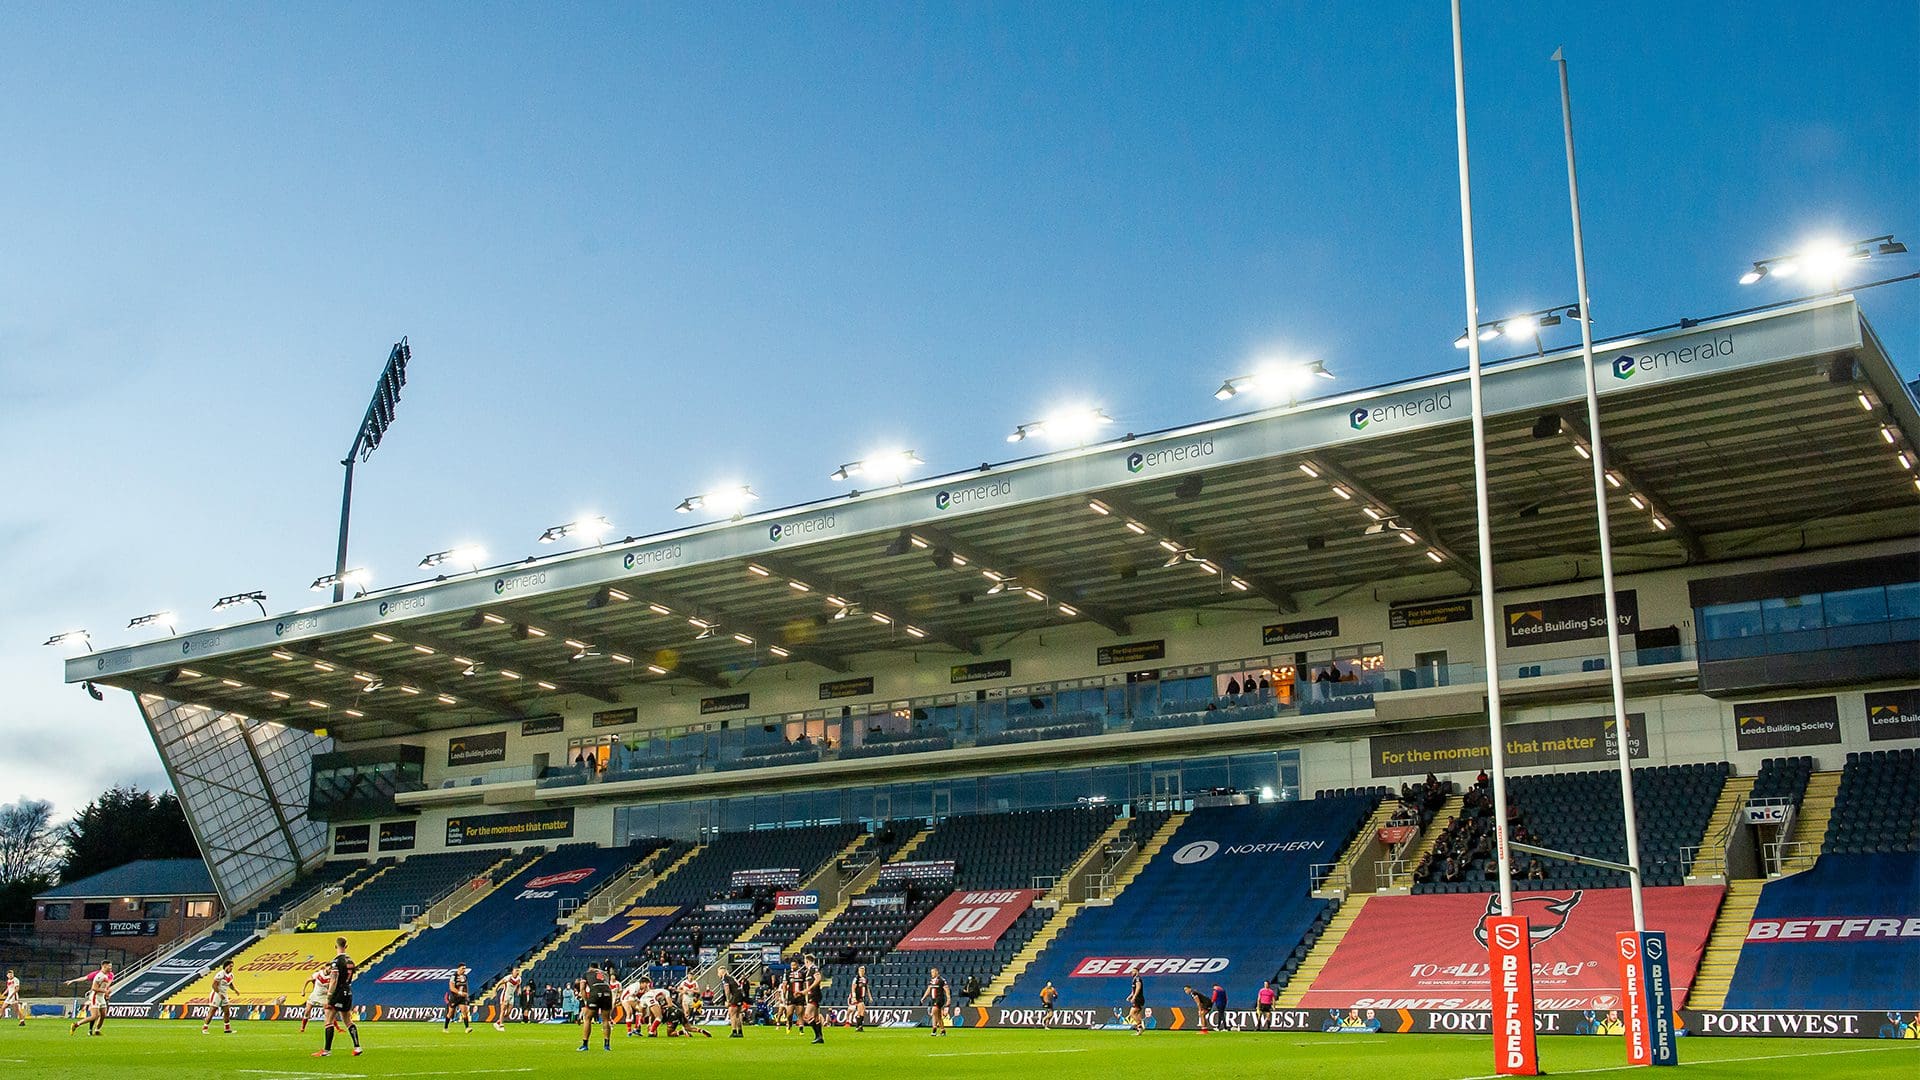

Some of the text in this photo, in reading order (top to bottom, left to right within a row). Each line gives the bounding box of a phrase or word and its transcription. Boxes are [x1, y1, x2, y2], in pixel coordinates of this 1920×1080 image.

[1639, 335, 1734, 372] emerald
[1371, 390, 1452, 423] emerald
[1146, 438, 1214, 467] emerald
[952, 479, 1011, 505] emerald
[783, 513, 836, 538] emerald
[636, 545, 682, 566] emerald
[505, 571, 547, 592] emerald
[389, 596, 425, 613] emerald
[284, 616, 318, 632] emerald
[1511, 624, 1543, 636] Leeds
[1545, 618, 1588, 632] Building
[1265, 628, 1333, 643] Leeds Building Society
[1740, 721, 1834, 736] Leeds Building Society
[1872, 715, 1900, 725] Leeds
[1382, 736, 1596, 765] For the momen that matter
[466, 820, 568, 836] For the moments that matter
[1224, 840, 1325, 855] NORTHERN
[777, 895, 818, 906] BETFRED
[109, 922, 142, 931] TRYZONE
[938, 906, 1001, 935] 10
[607, 919, 649, 943] 7
[254, 949, 300, 963] cash
[238, 959, 332, 972] converter
[382, 968, 472, 981] BETFRE
[1077, 957, 1230, 975] BETFRED
[1349, 998, 1467, 1009] SAINTS
[1502, 954, 1524, 1069] BETFRED
[1626, 963, 1644, 1060] BETFRED
[1651, 964, 1671, 1060] BETFRED
